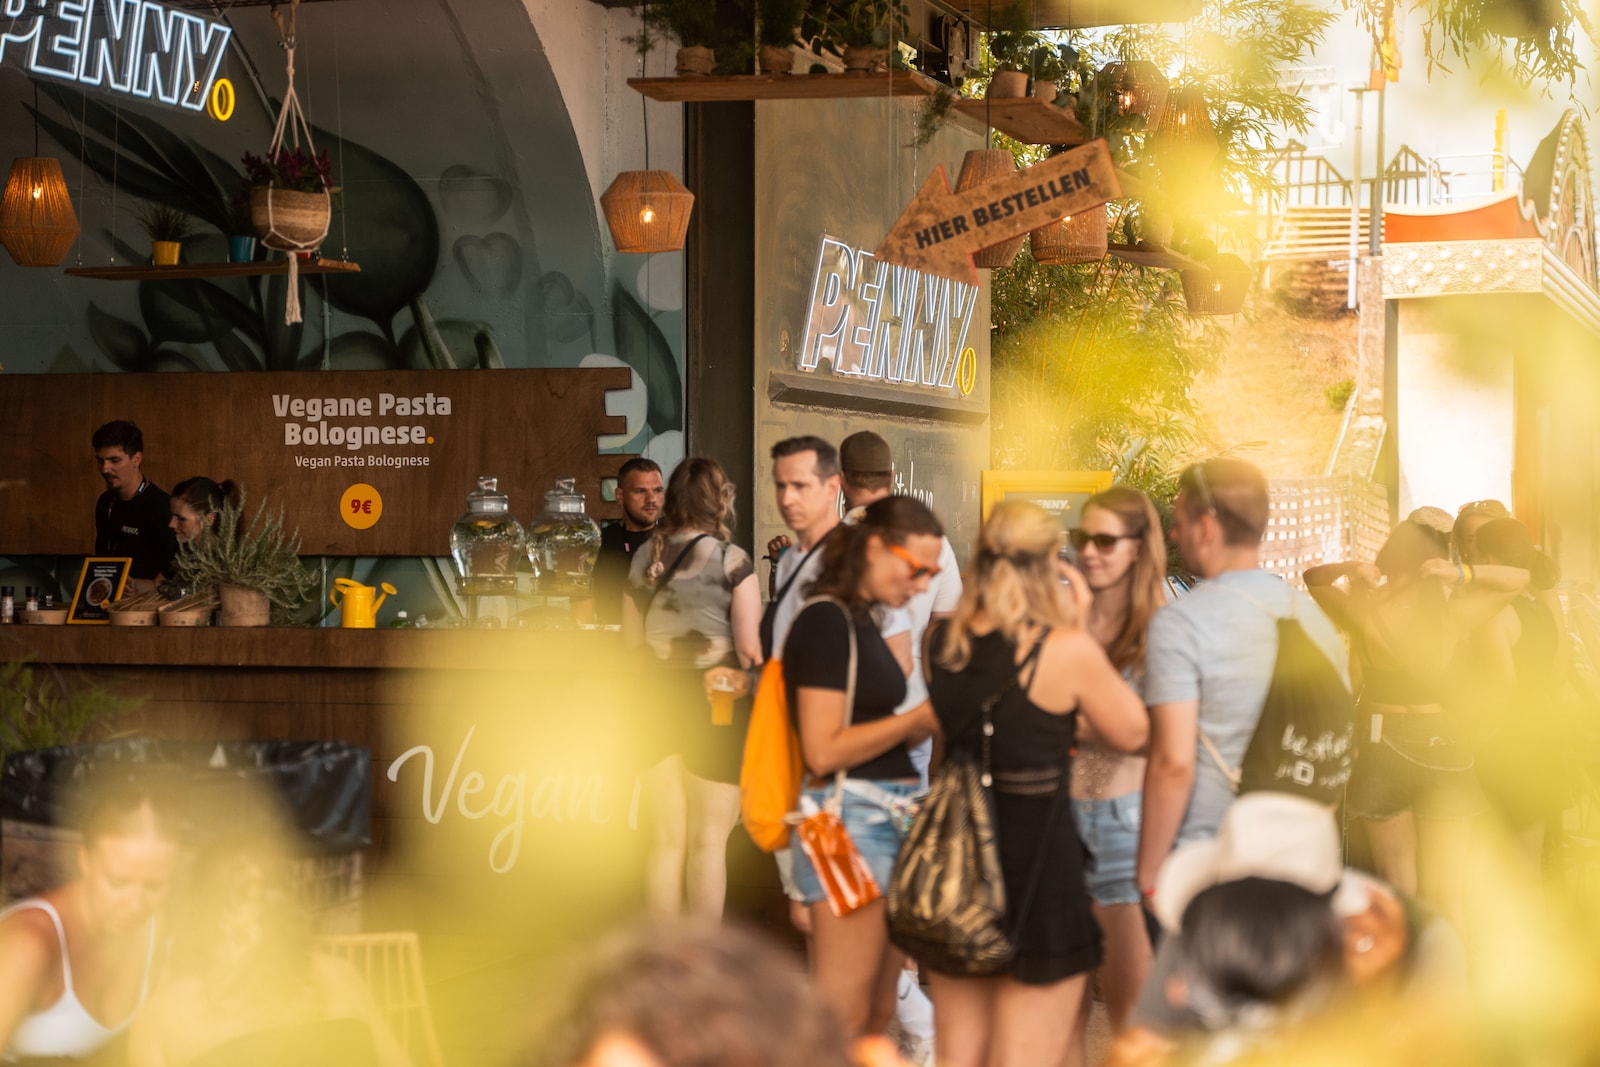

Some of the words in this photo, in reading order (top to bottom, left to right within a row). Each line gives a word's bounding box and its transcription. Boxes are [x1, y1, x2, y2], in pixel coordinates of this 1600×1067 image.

[914, 214, 971, 251] HIER
[970, 167, 1092, 228] BESTELLEN
[272, 394, 372, 422] Vegane
[378, 392, 452, 416] Pasta
[284, 420, 435, 450] Bolognese.
[294, 455, 332, 469] Vegan
[334, 455, 365, 467] Pasta
[367, 454, 430, 469] Bolognese
[350, 499, 373, 515] 9€
[386, 723, 612, 874] Vegan
